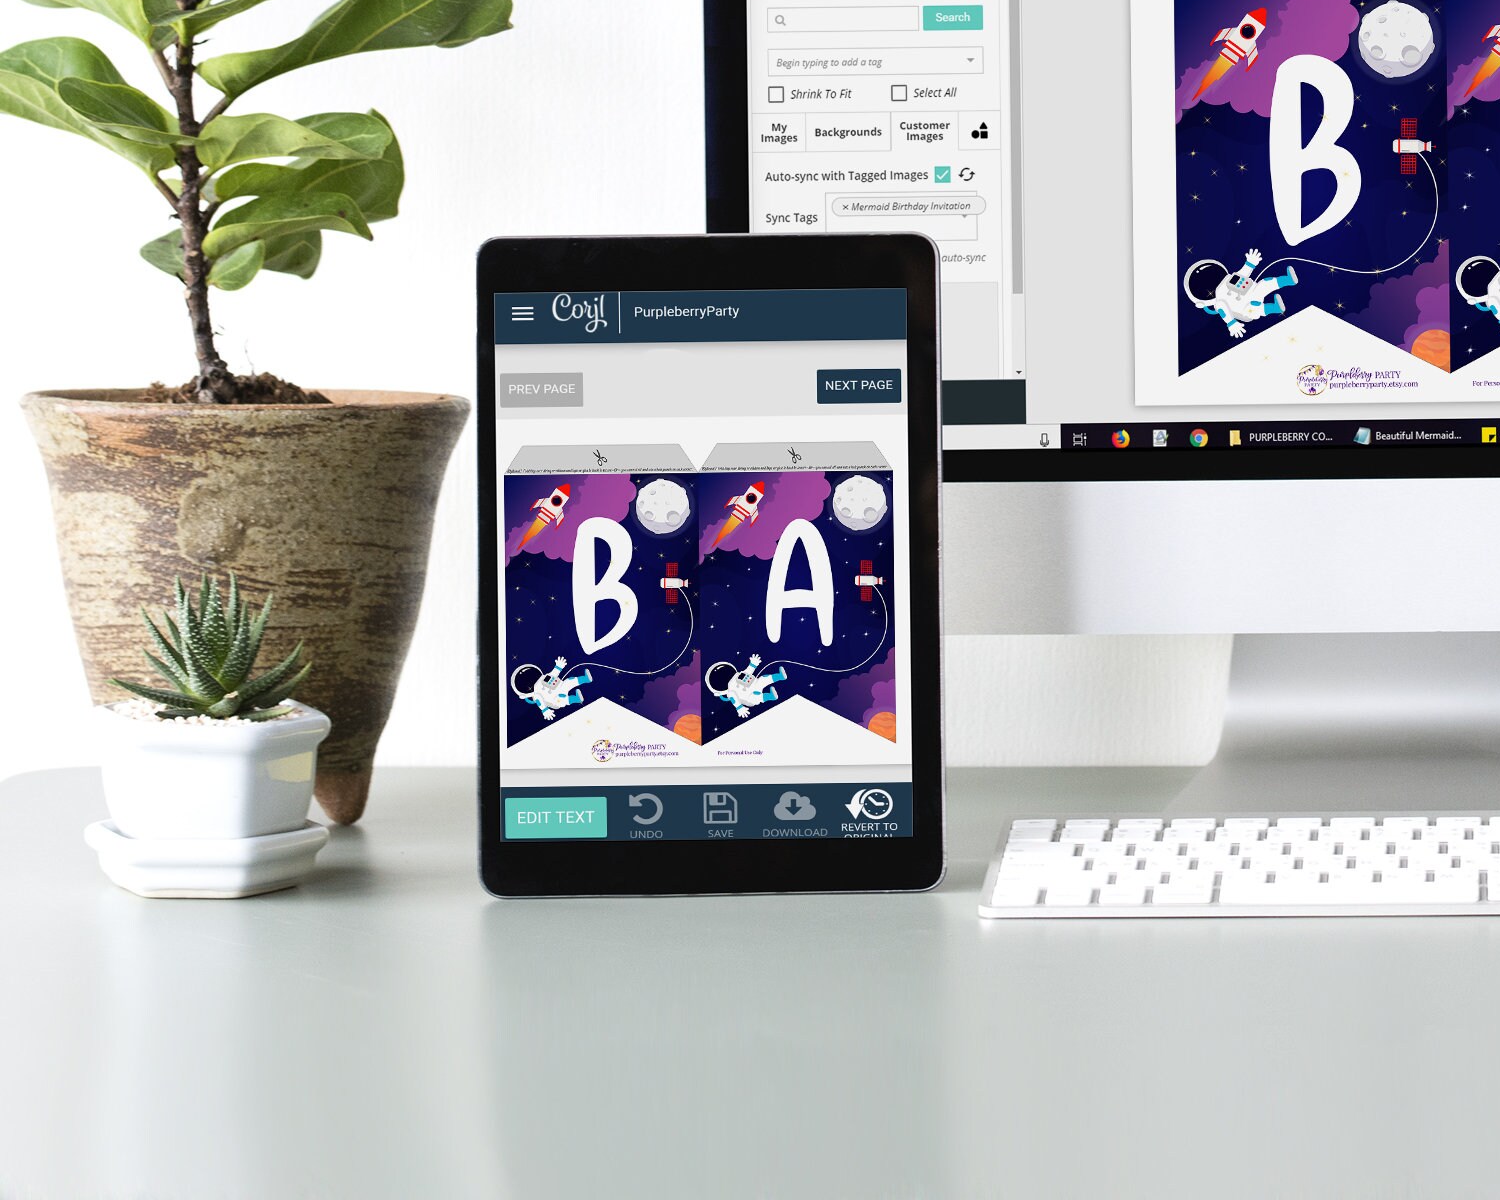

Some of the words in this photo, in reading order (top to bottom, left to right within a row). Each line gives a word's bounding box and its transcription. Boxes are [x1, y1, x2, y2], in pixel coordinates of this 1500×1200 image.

[935, 12, 971, 22] Search
[776, 58, 800, 70] Begin
[802, 59, 829, 70] typing
[830, 59, 839, 67] to
[841, 57, 859, 67] add
[868, 59, 883, 69] tag
[790, 89, 822, 100] Shrink
[825, 89, 837, 99] To
[839, 88, 852, 99] Fit
[913, 88, 942, 98] Select
[944, 87, 957, 97] All
[772, 123, 787, 134] My
[899, 121, 950, 130] Customer
[761, 132, 798, 145] Images
[815, 127, 882, 139] Backgrounds
[907, 132, 944, 143] Images
[1269, 54, 1362, 247] B
[765, 172, 819, 184] Auto-sync
[821, 170, 845, 181] with
[848, 170, 887, 183] Tagged
[890, 171, 929, 182] Images
[851, 202, 890, 211] Mermaid
[892, 202, 929, 213] Birthday
[930, 202, 971, 210] Invitation
[766, 213, 790, 225] Sync
[793, 212, 818, 225] Tags
[940, 253, 987, 265] auto-sync
[552, 293, 609, 333] Corjl
[634, 306, 739, 320] PurpleberryParty
[1374, 370, 1401, 379] PARTY
[509, 384, 540, 394] PREV
[544, 384, 575, 394] PAGE
[825, 380, 858, 390] NEXT
[861, 380, 893, 390] PAGE
[1249, 432, 1310, 442] PURPLEBERRY
[1376, 431, 1413, 440] Beautiful
[572, 516, 639, 655] B
[765, 518, 834, 647] A
[517, 811, 552, 824] EDIT
[555, 810, 595, 823] TEXT
[841, 823, 880, 831] REVERT
[883, 823, 898, 831] TO
[630, 830, 663, 840] UNDO
[708, 829, 736, 839] SAVE
[760, 828, 830, 839] DOWNLOAD
